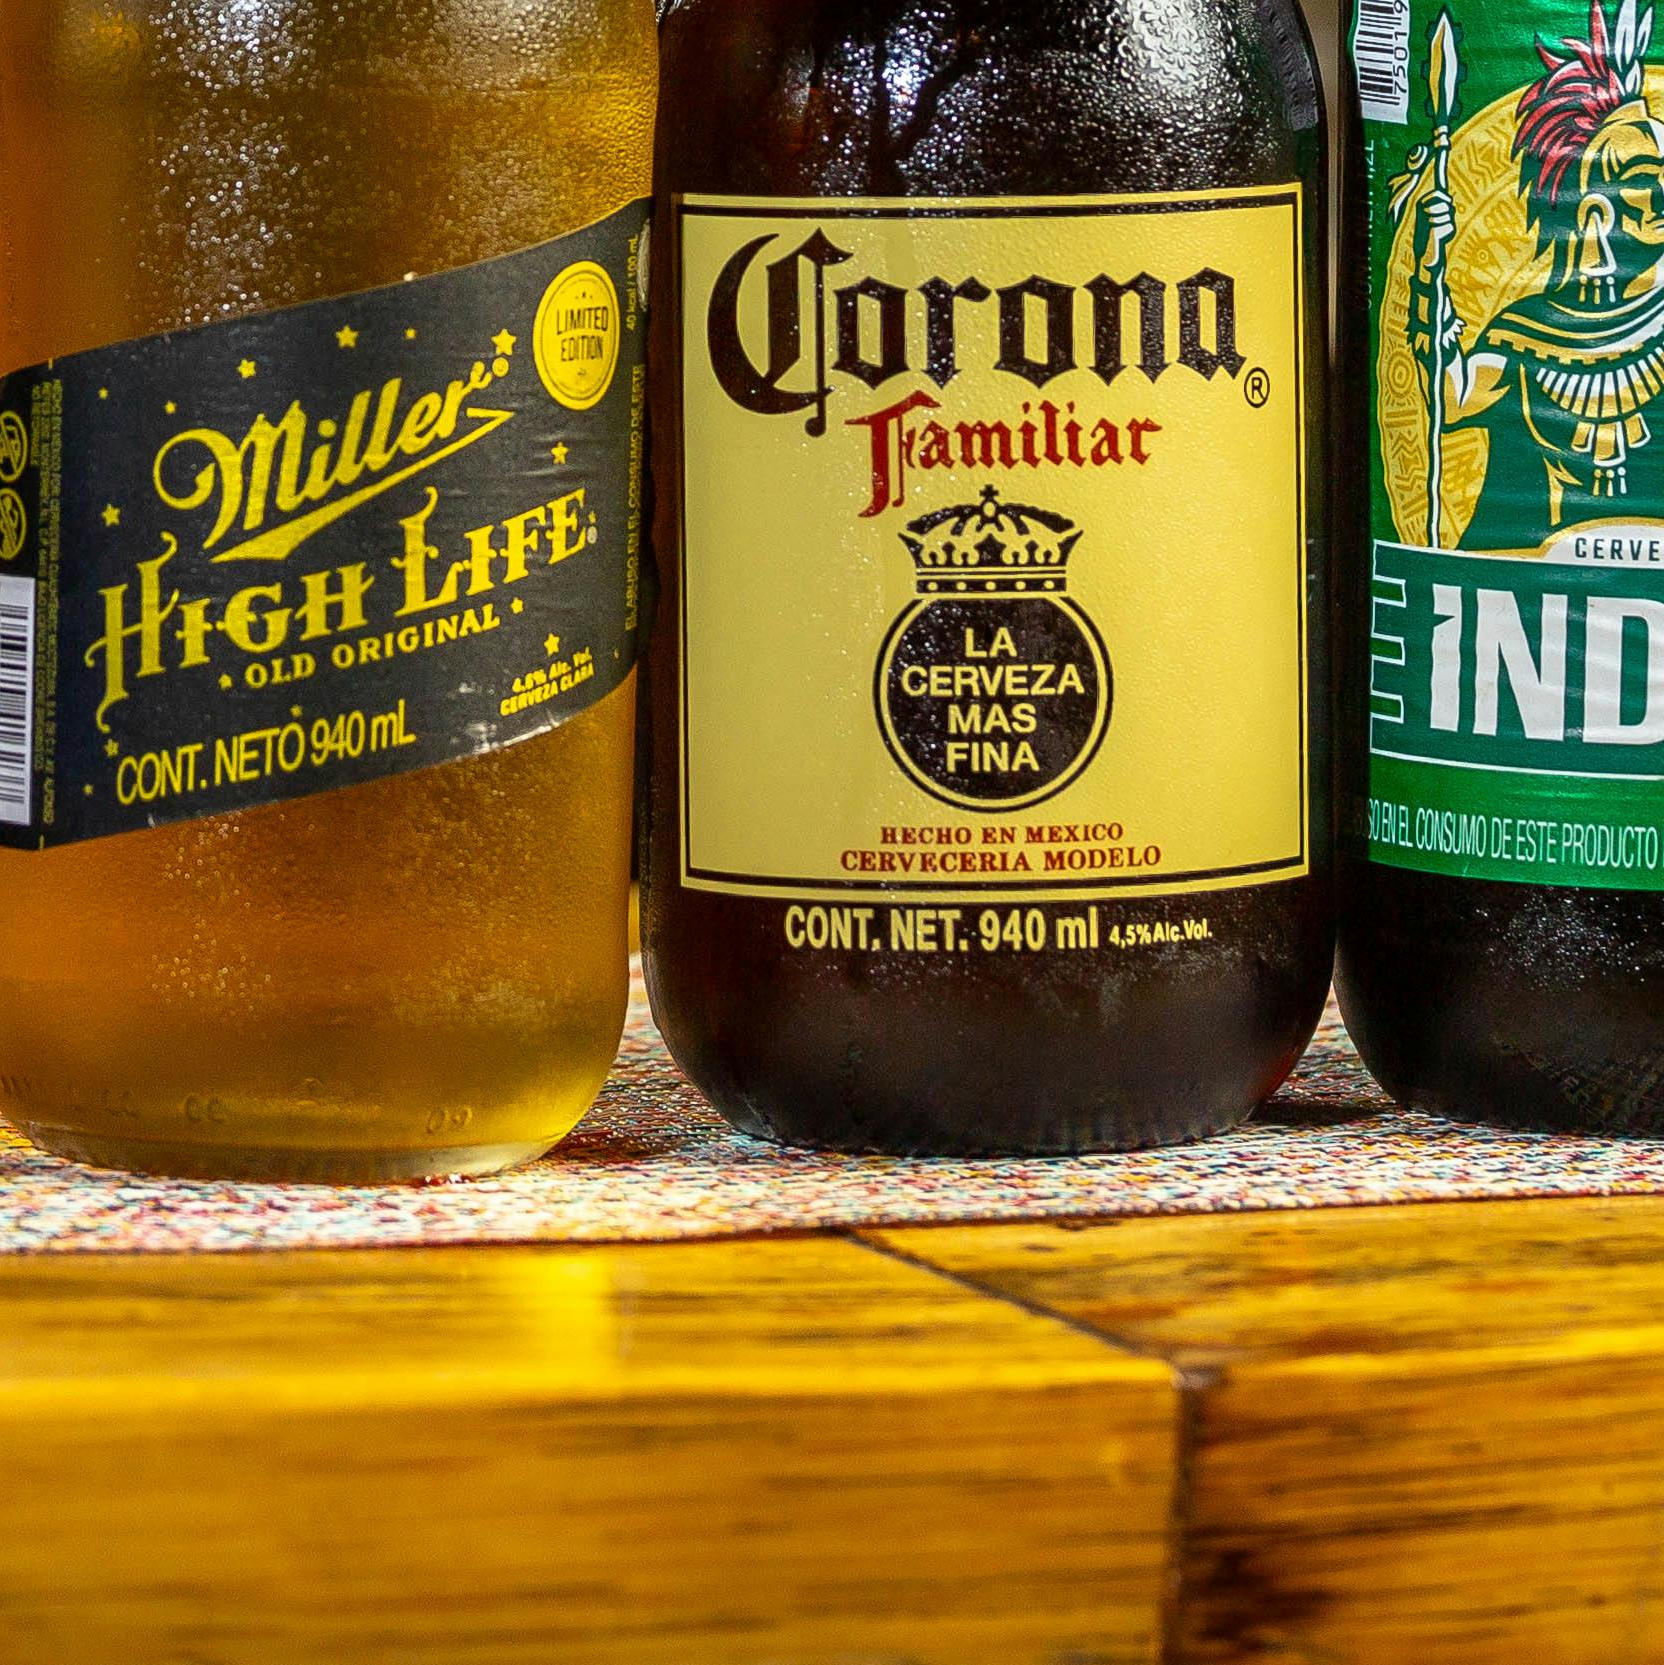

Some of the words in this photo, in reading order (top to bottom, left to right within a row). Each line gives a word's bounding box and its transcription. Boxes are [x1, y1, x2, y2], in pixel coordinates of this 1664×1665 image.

[556, 306, 609, 335] LIMITED
[707, 227, 1247, 437] Corona
[560, 335, 604, 362] EDITION
[152, 359, 495, 549] Miller
[844, 389, 1163, 519] Familiar
[85, 532, 376, 733] HIGH
[390, 487, 587, 618] LIFE
[244, 653, 316, 689] OLD
[338, 607, 501, 671] ORIGINAL
[964, 626, 1018, 658] LA
[901, 664, 1085, 697] CERVEZA
[947, 702, 1038, 734] MAS
[116, 742, 208, 806] CONT.
[214, 722, 306, 786] NETO
[310, 710, 366, 767] 940
[370, 697, 417, 752] mL
[946, 741, 1041, 773] FINA
[880, 826, 973, 845] HECHO
[981, 826, 1016, 845] EN
[1024, 822, 1124, 844] MEXICO
[1381, 801, 1396, 844] EN
[1398, 804, 1414, 849] EL
[1415, 807, 1487, 858] CONSUMO
[1490, 816, 1513, 860] DE
[1516, 819, 1558, 864] ESTE
[1561, 822, 1659, 870] PRODUCTO
[840, 848, 1032, 873] CERVECERIA
[1042, 845, 1162, 872] MODELO
[785, 904, 880, 951] CONT.
[890, 907, 969, 952] NET.
[979, 907, 1046, 952] 940
[1055, 905, 1100, 950] ml
